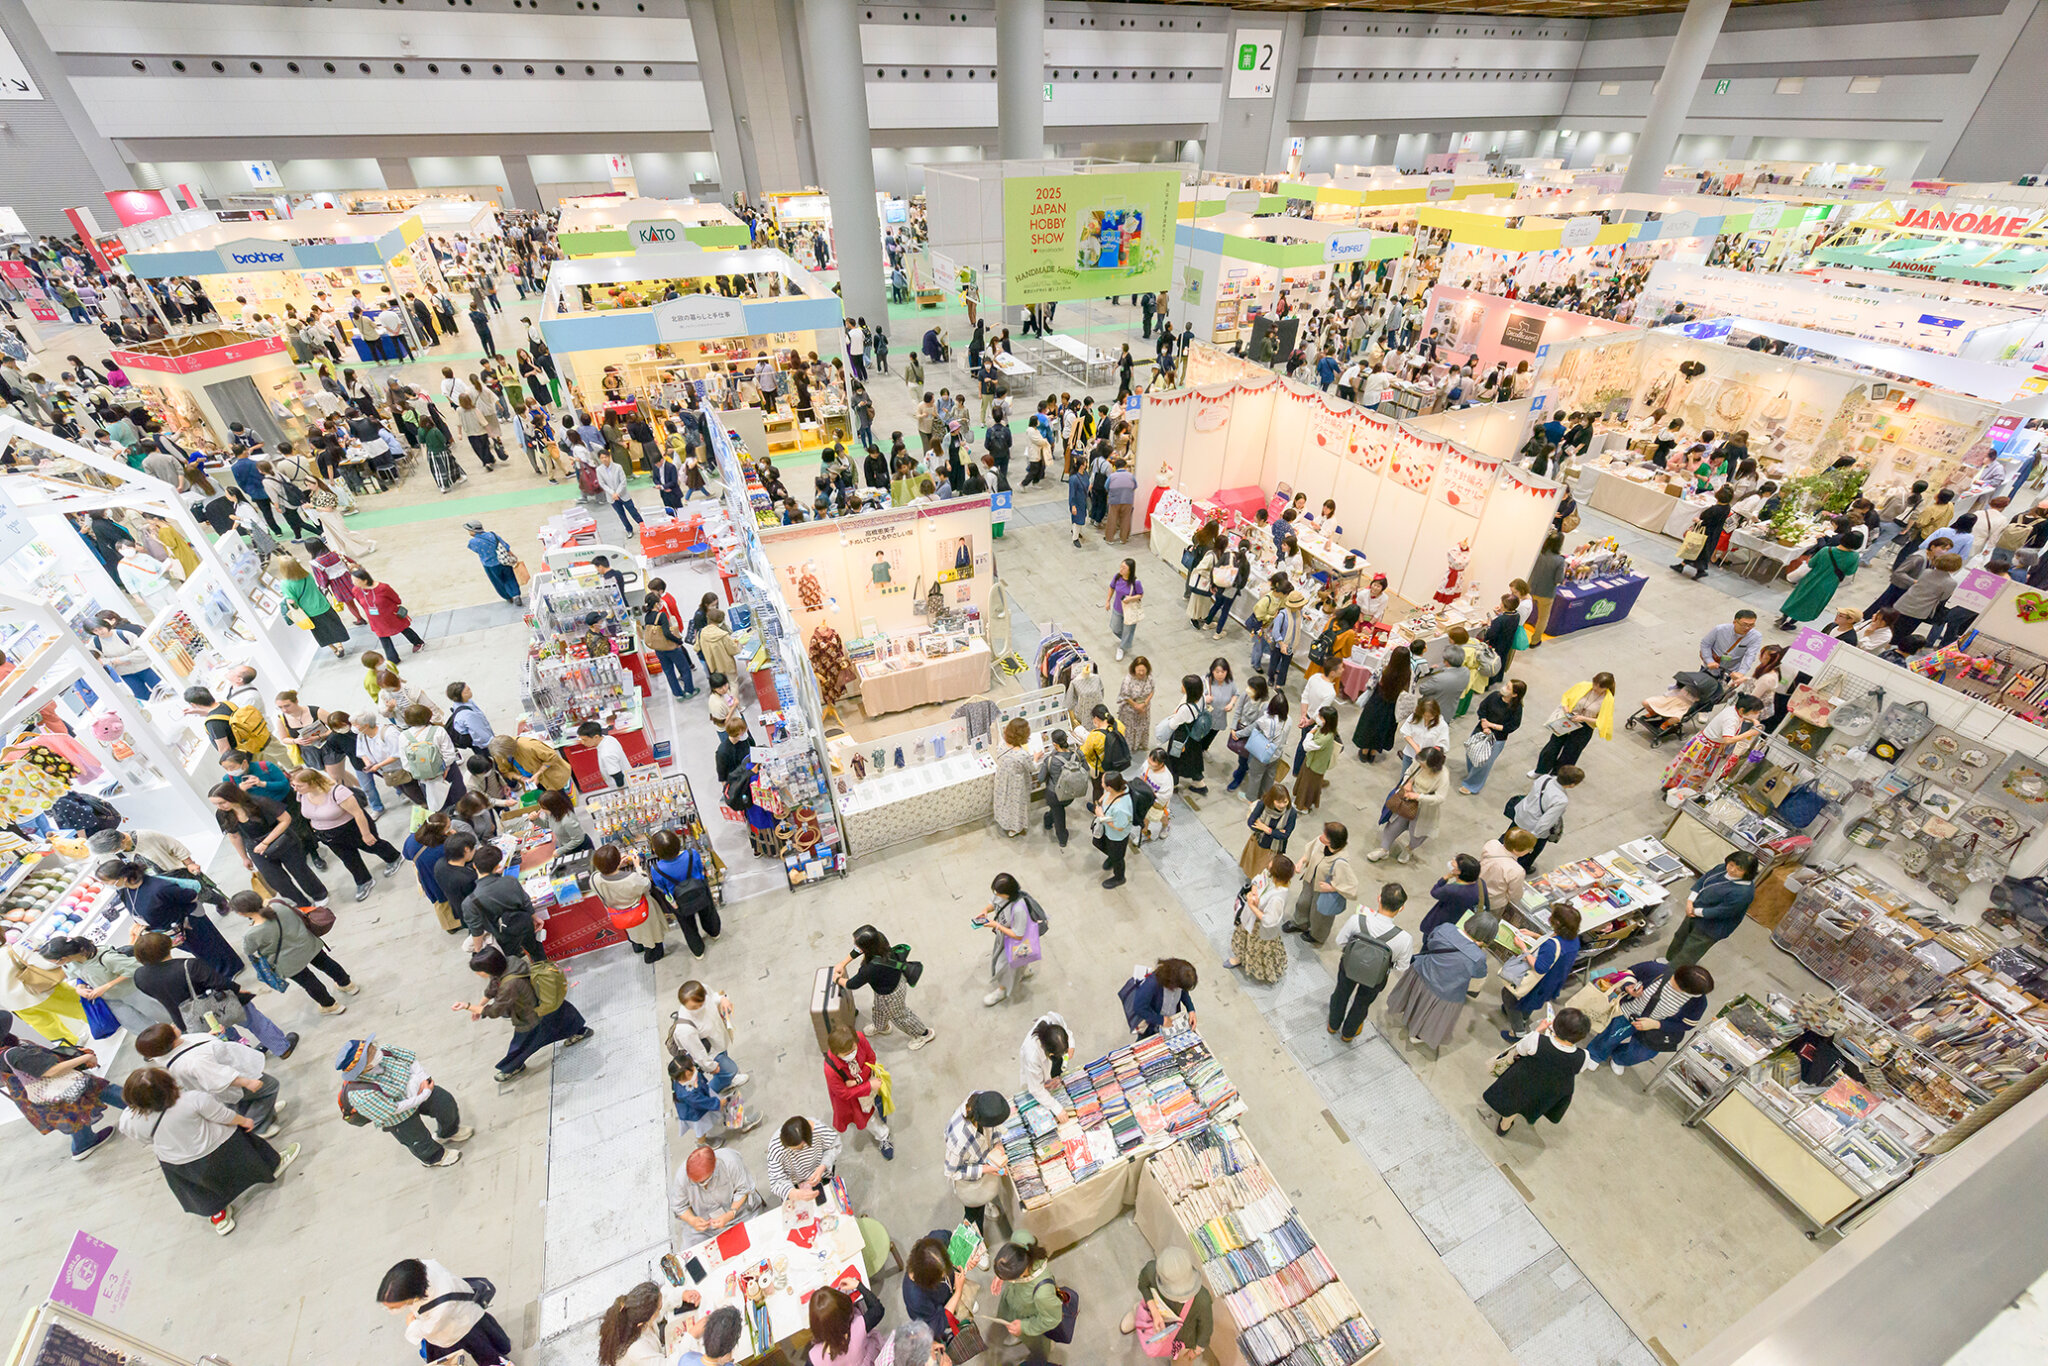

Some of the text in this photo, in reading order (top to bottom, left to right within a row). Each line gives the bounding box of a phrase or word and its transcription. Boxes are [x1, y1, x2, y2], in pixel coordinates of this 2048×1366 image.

[1260, 44, 1273, 70] 2
[1036, 187, 1062, 200] 2025
[1030, 202, 1067, 216] JAPAN
[1030, 218, 1066, 230] HOBBY
[1895, 208, 2029, 238] JANOME
[639, 225, 676, 242] KATO
[1031, 232, 1065, 245] SHOW
[232, 252, 284, 264] brother
[1015, 265, 1056, 283] HANDMADE
[1888, 260, 1936, 274] JANOME
[671, 311, 731, 322] 北欧の暮らしと手仕事
[65, 1254, 82, 1284] WORLD
[103, 1274, 120, 1299] E-3
